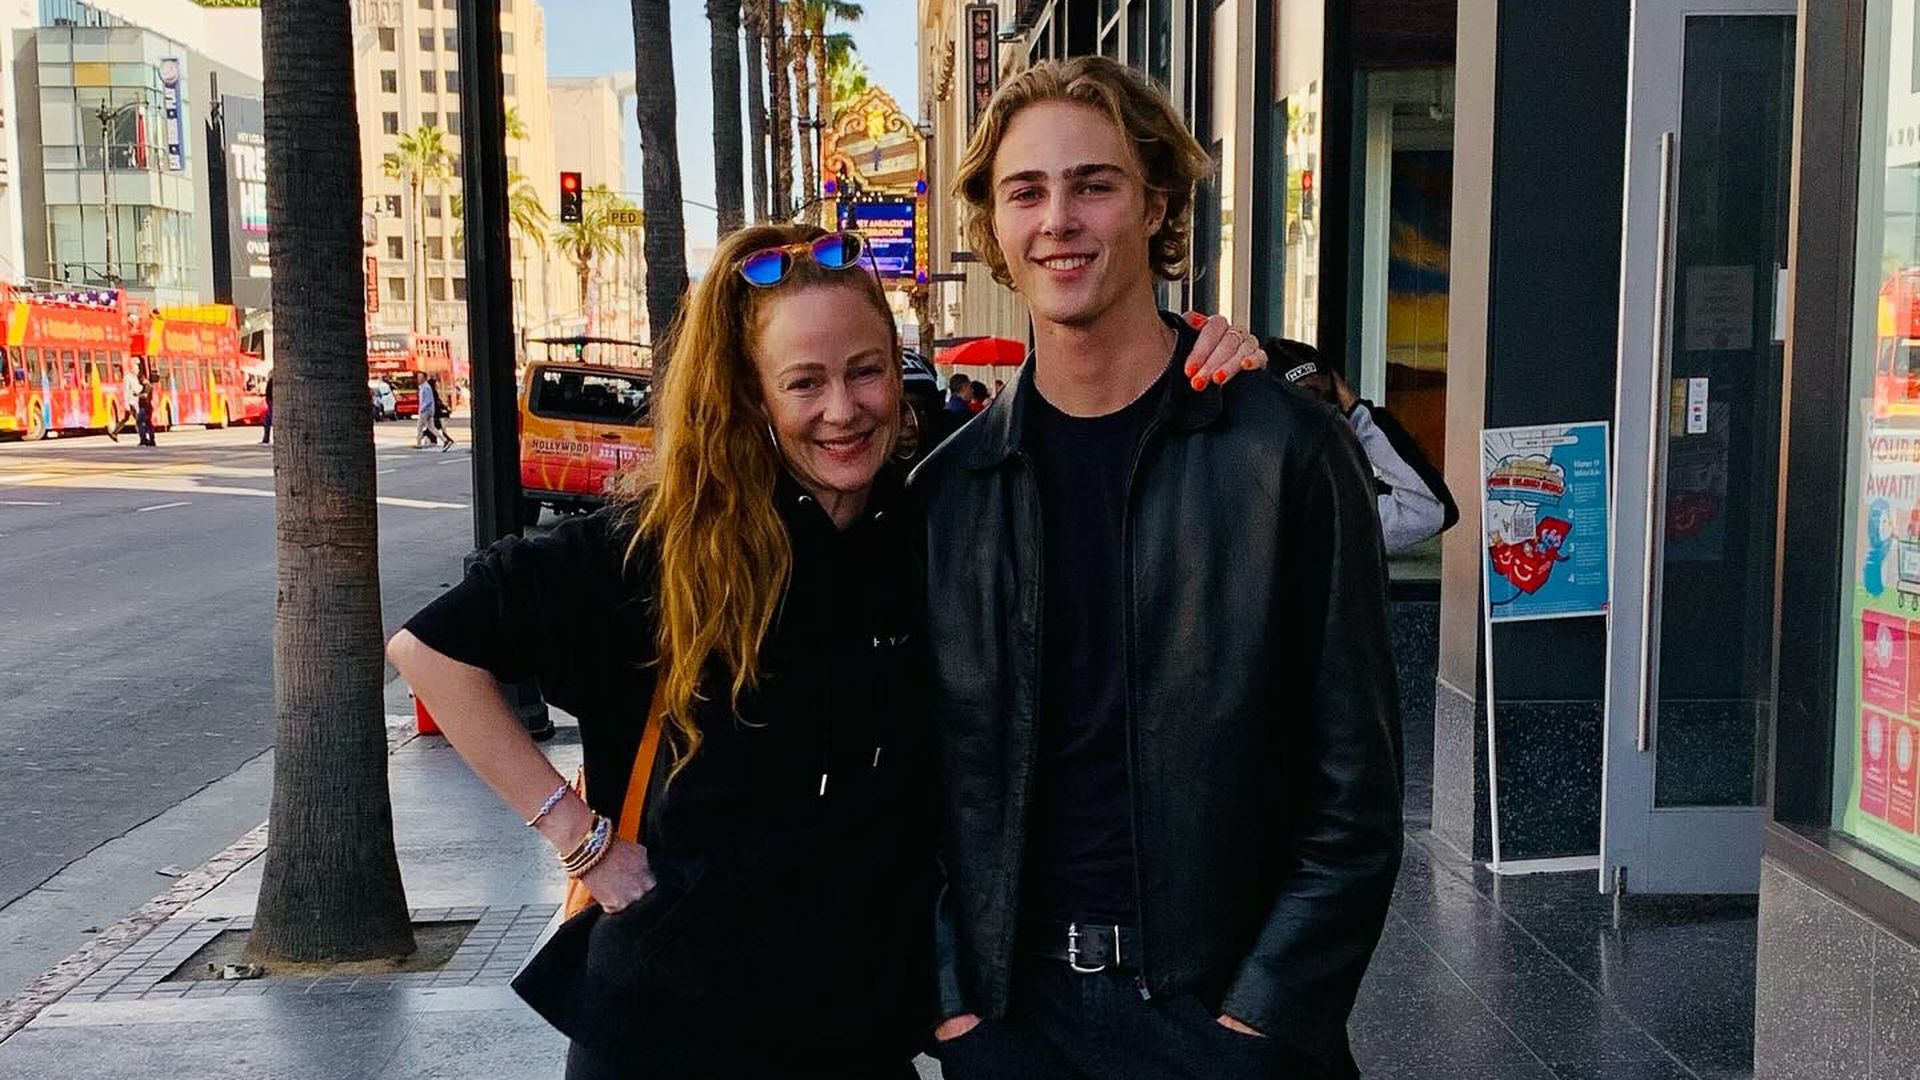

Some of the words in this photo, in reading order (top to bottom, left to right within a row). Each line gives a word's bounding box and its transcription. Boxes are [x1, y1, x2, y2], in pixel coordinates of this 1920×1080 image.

[612, 212, 636, 223] PED
[532, 439, 589, 453] HOLLYWOOD
[1868, 436, 1909, 461] YOUR
